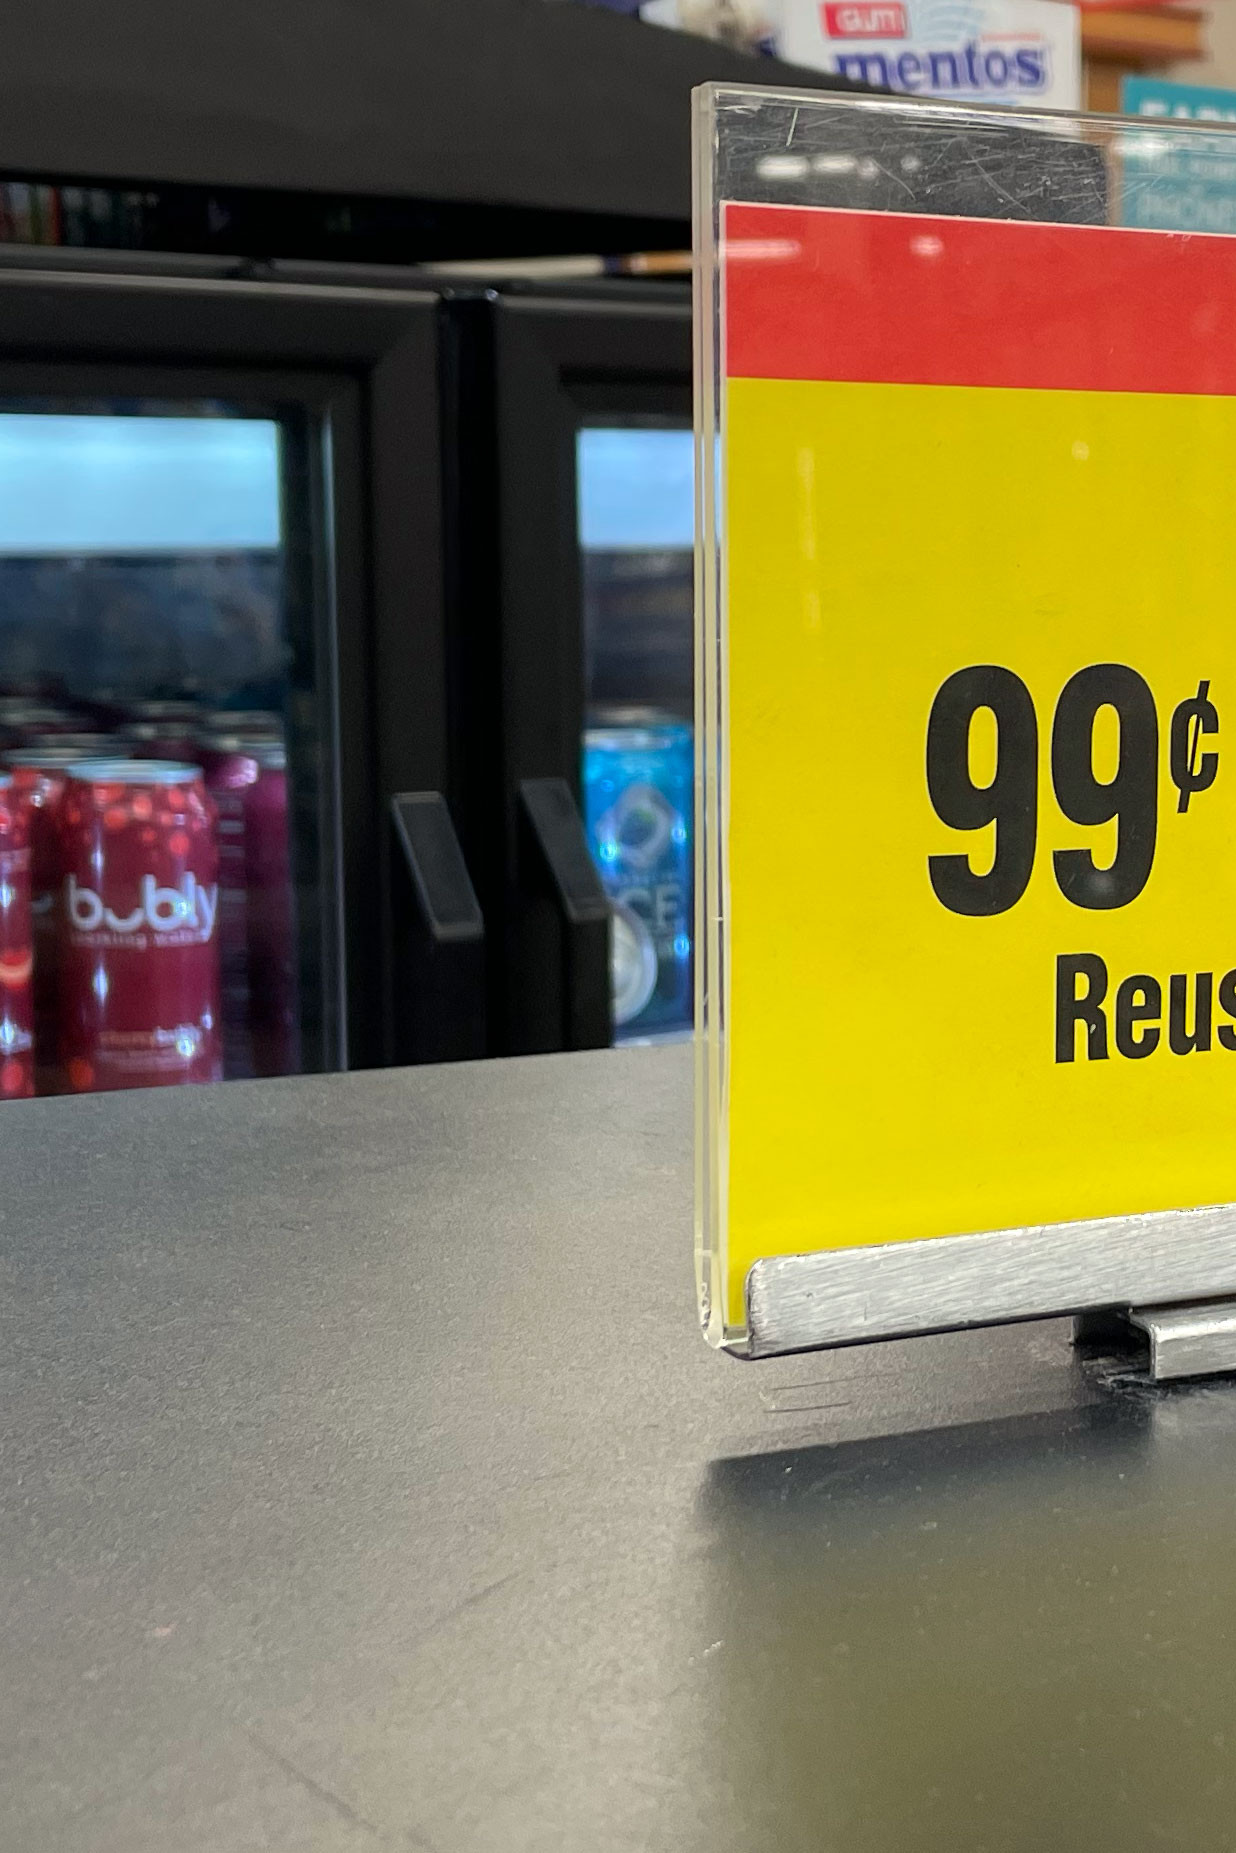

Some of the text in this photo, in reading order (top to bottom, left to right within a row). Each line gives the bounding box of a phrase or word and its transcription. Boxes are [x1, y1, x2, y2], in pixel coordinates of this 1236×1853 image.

[836, 8, 899, 34] GUM
[834, 40, 1050, 90] mentos
[66, 871, 218, 943] bubly
